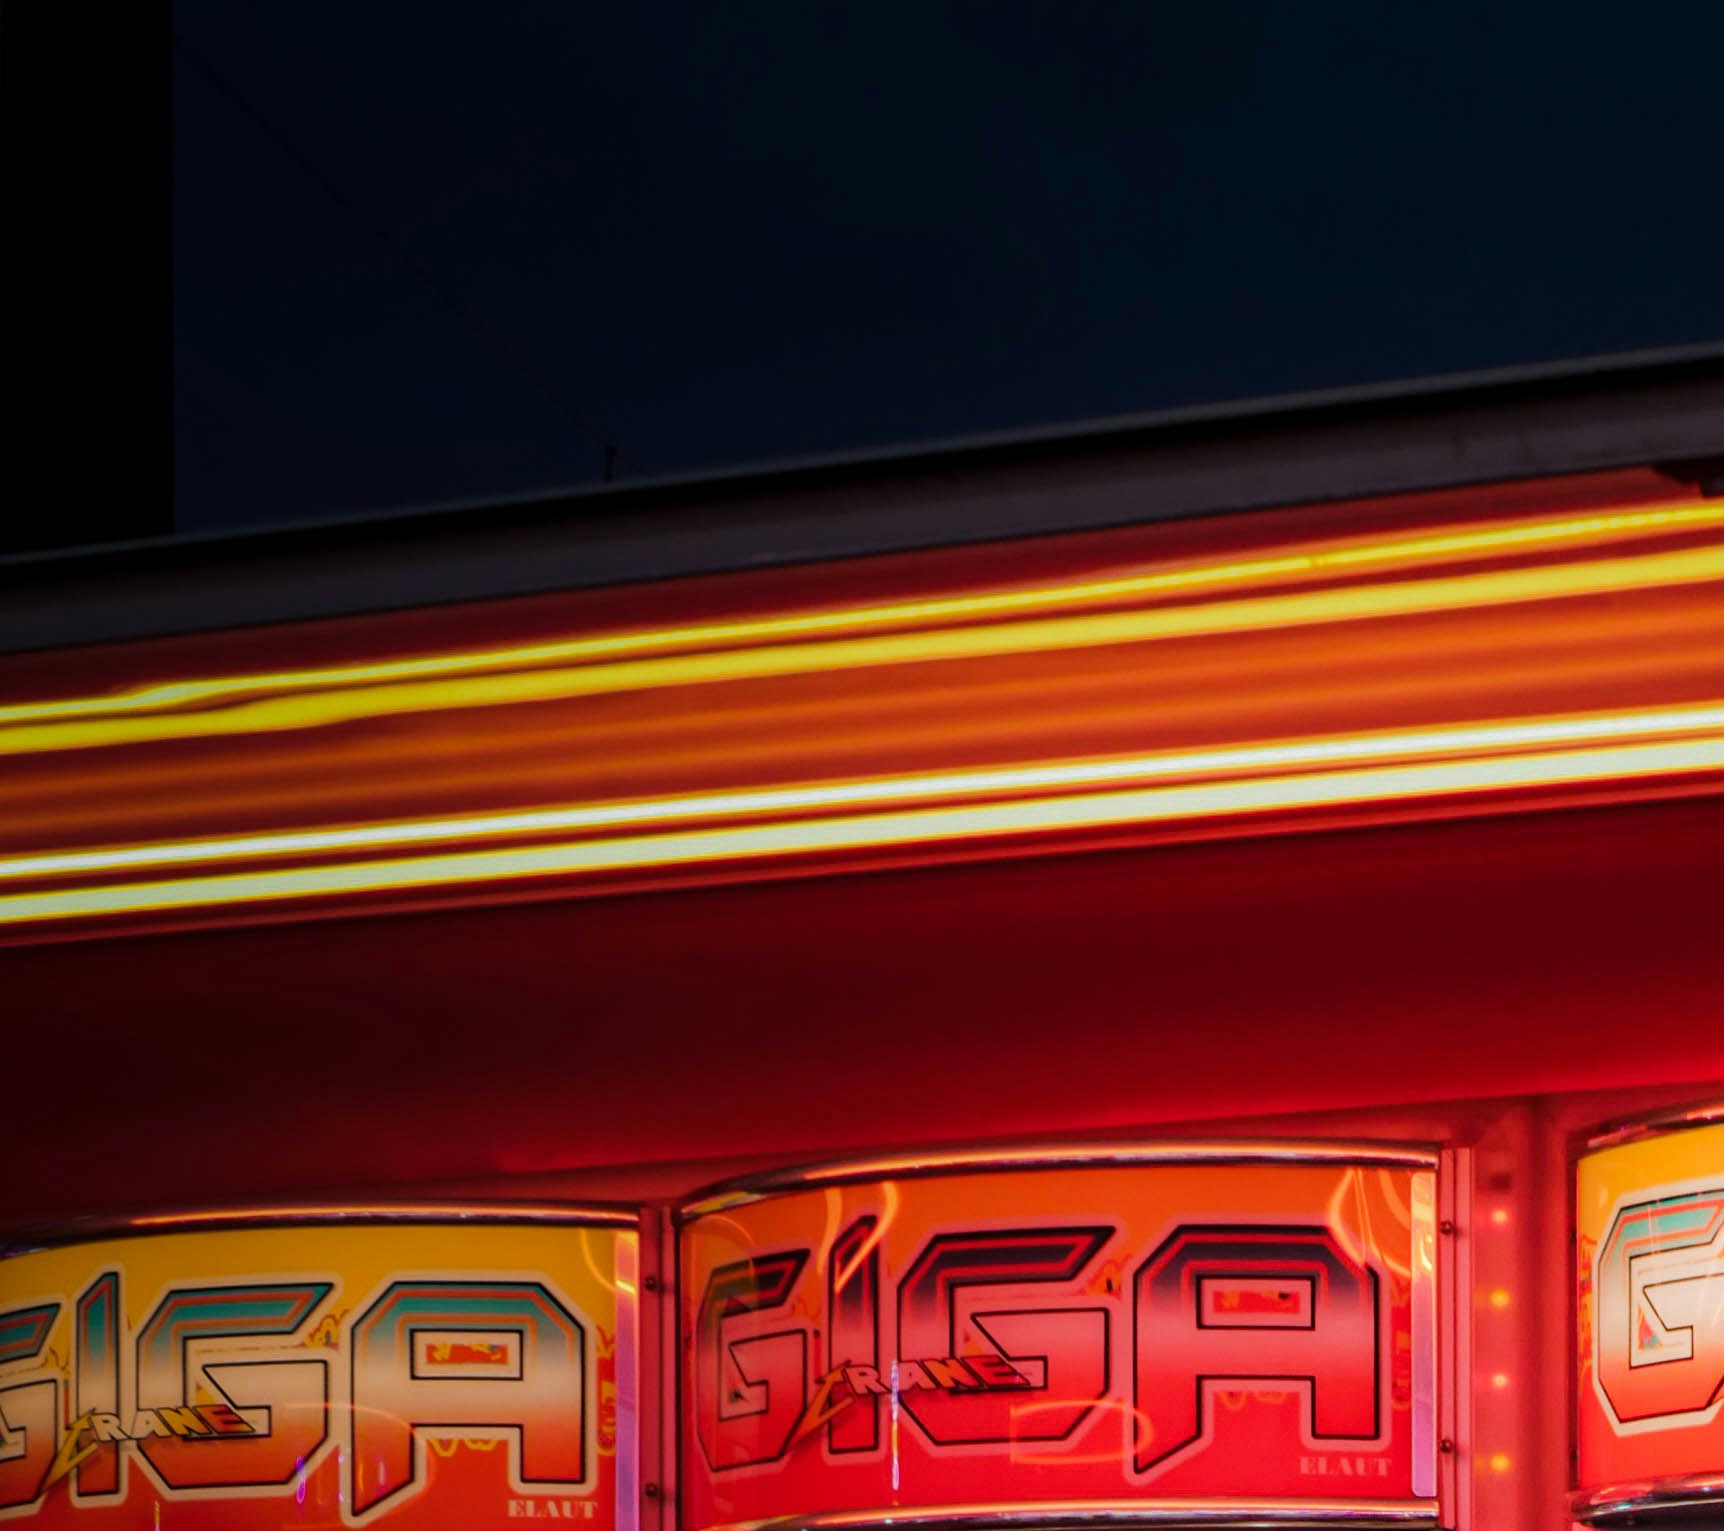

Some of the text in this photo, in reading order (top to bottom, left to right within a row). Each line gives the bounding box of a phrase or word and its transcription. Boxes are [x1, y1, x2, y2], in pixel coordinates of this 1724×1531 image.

[697, 1213, 1382, 1476] GIGA
[1298, 1454, 1393, 1479] ELAUT
[506, 1498, 599, 1521] ELAUT
